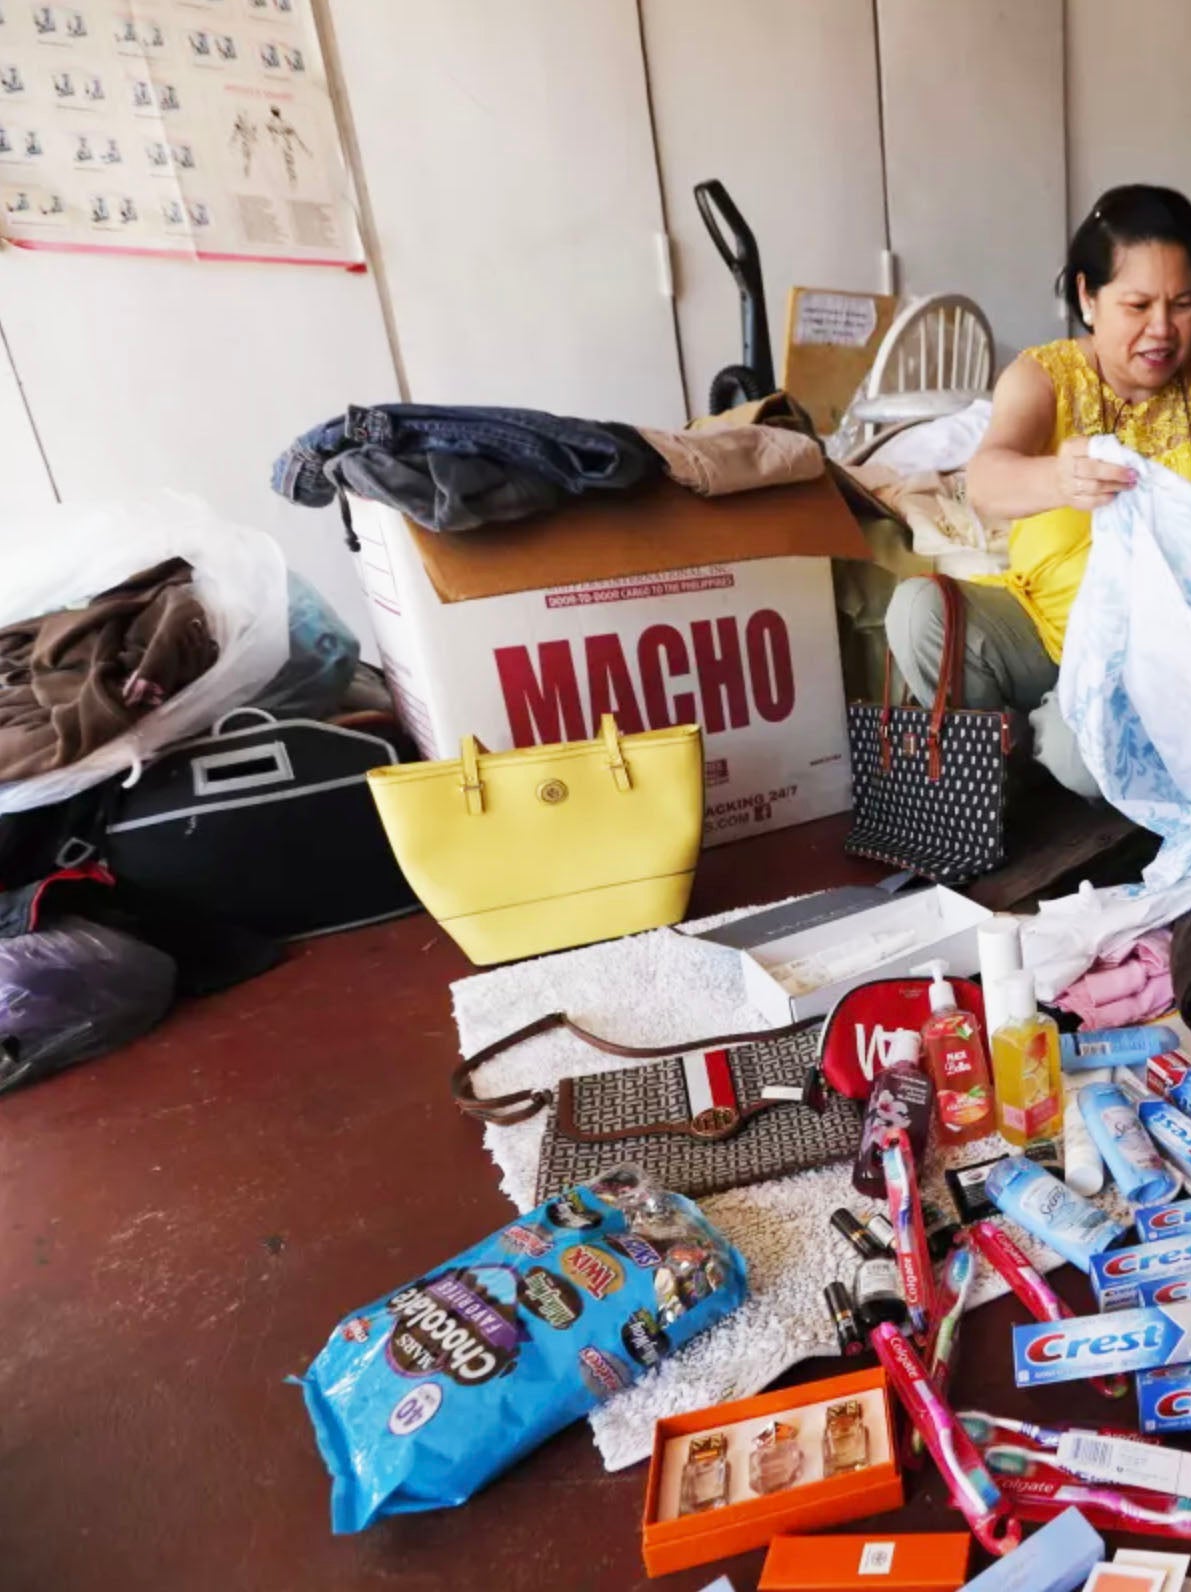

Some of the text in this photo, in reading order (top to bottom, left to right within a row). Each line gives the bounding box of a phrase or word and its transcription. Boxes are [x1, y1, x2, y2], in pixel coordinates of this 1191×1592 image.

[621, 585, 650, 600] CARGO
[652, 583, 663, 595] TO
[664, 581, 679, 593] THE
[681, 576, 733, 592] PHILIPPINES
[493, 608, 796, 749] MACHO
[705, 785, 798, 818] ACKING 24/7
[904, 1256, 918, 1304] Colgate
[437, 1279, 503, 1335] FAVORITES
[389, 1286, 497, 1381] Chocolate
[394, 1331, 437, 1371] MARS
[1025, 1321, 1164, 1364] Crest
[888, 1335, 920, 1381] Colgate
[999, 1477, 1055, 1494] olgate
